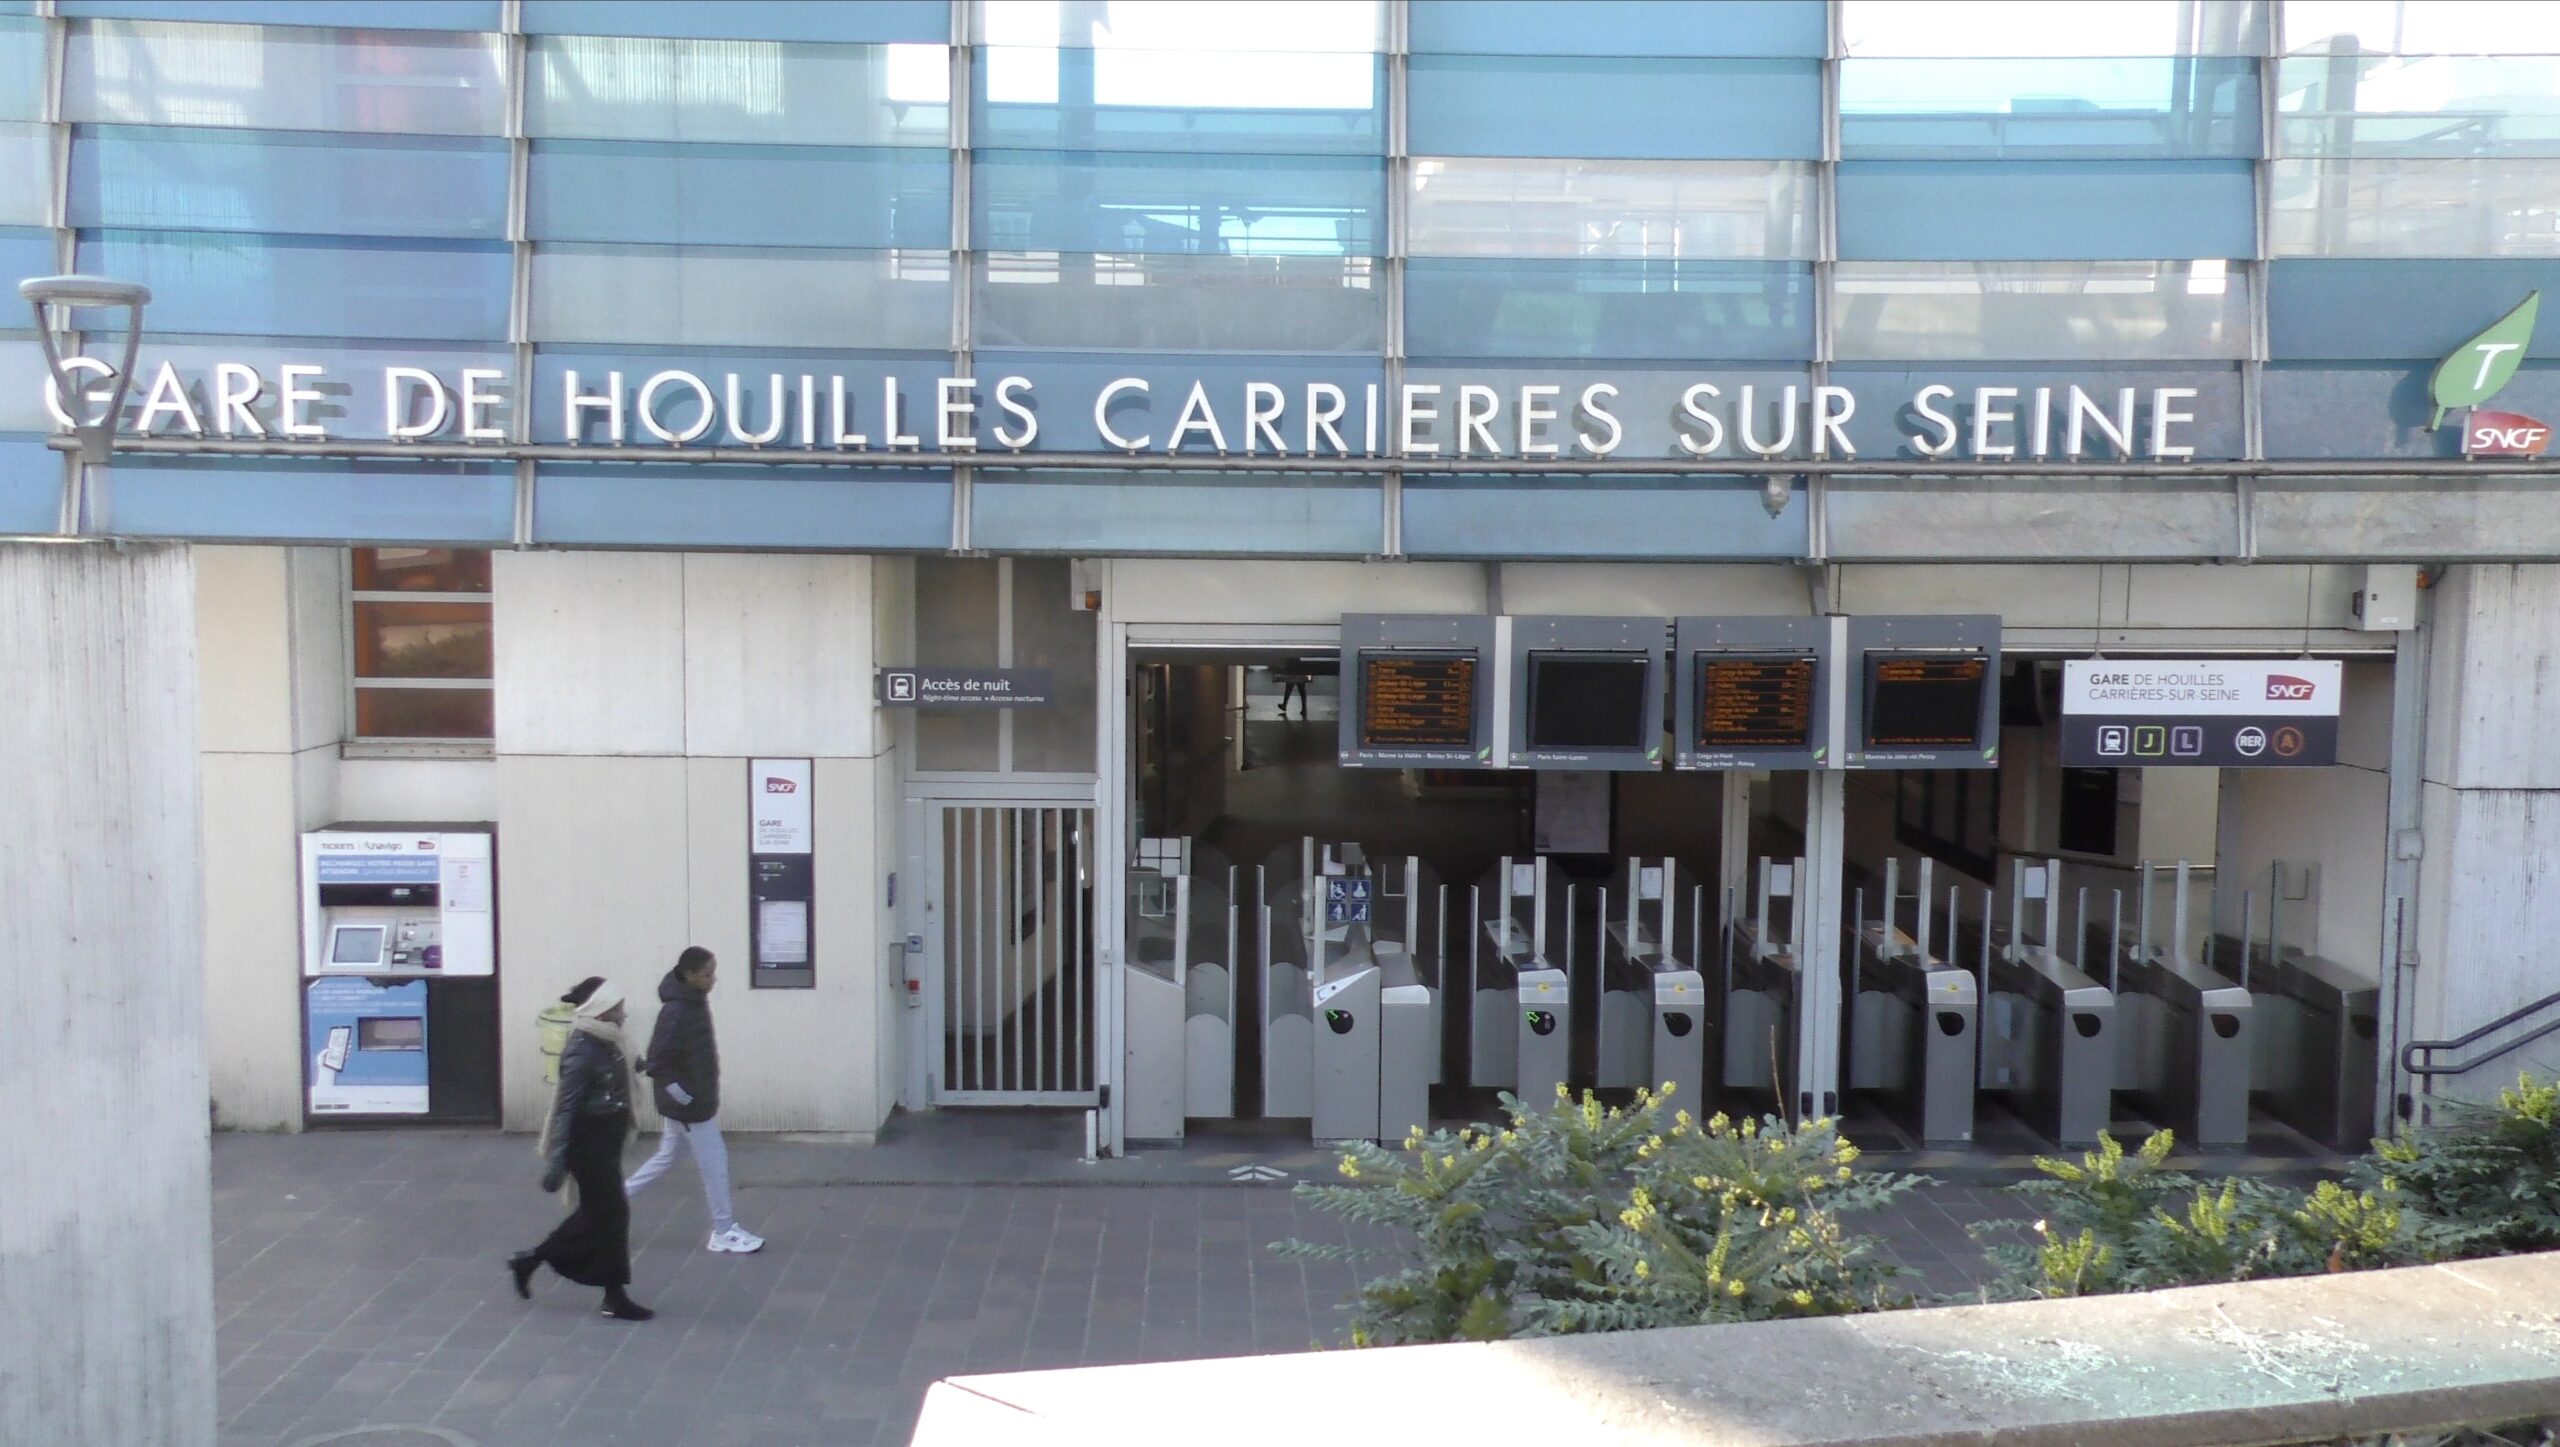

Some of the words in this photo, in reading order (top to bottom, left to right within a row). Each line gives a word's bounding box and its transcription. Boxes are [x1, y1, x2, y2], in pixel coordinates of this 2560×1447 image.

[2473, 343, 2520, 390] T
[45, 357, 326, 435] GARE
[386, 367, 506, 438] DE
[565, 370, 1038, 447] HOUILLES
[1095, 377, 1622, 454] CARRIERES
[1680, 383, 1857, 455] SUR
[1913, 385, 2198, 456] SEINE
[2471, 428, 2547, 448] SNCF
[922, 678, 961, 691] Accès
[964, 678, 980, 691] de
[984, 679, 1011, 691] nuit
[2090, 674, 2129, 685] GARE
[2134, 674, 2152, 686] DE
[2157, 674, 2224, 686] HOUILLES
[2089, 687, 2240, 701] CARRIÈRES-SUR-SEINE
[2268, 684, 2313, 698] SNCF
[2144, 733, 2153, 748] J
[2182, 733, 2193, 748] L
[2240, 736, 2262, 747] RER
[2282, 734, 2294, 748] A
[768, 783, 795, 792] SNCF
